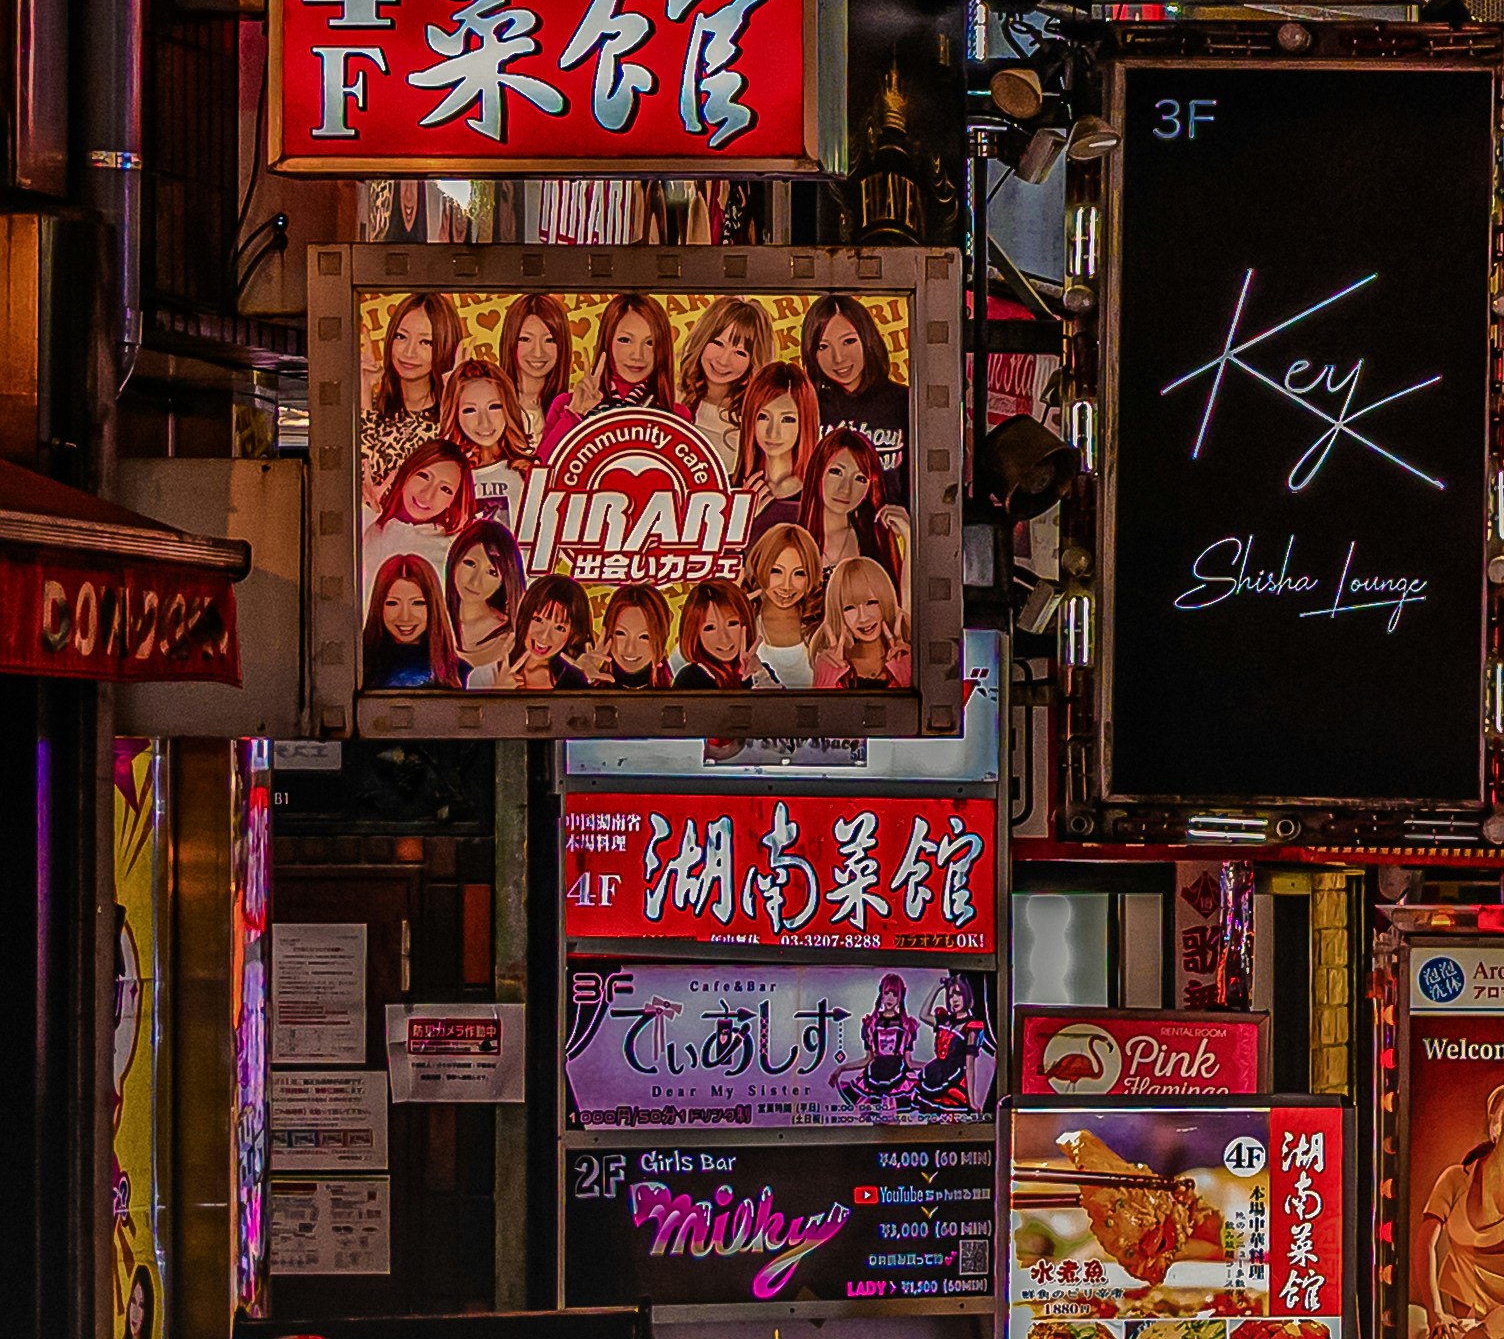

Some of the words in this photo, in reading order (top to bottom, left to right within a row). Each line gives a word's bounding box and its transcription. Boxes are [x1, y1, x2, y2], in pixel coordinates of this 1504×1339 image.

[1152, 98, 1218, 140] 3F
[1161, 267, 1445, 492] Key
[563, 432, 673, 488] community
[673, 440, 708, 485] cafe
[574, 552, 741, 583] 出会いカフェ
[1174, 534, 1320, 610] Shisha
[1299, 541, 1427, 634] Lounge
[643, 801, 984, 935] 湖南菜館
[566, 871, 622, 907] 4F
[780, 933, 881, 949] 03-3207-8288
[572, 973, 634, 1004] 3F
[689, 980, 778, 994] Cafe&Bar
[1125, 1035, 1220, 1079] Pink
[652, 1085, 697, 1099] Dear
[710, 1085, 735, 1100] My
[748, 1084, 812, 1099] Sister
[640, 1150, 694, 1174] Girls
[700, 1154, 737, 1172] Bar
[1225, 1143, 1265, 1169] 4F
[574, 1154, 627, 1199] 2F
[879, 1186, 924, 1204] YouTube
[1279, 1131, 1326, 1312] 湖南菜館
[1030, 1259, 1108, 1285] 水煮魚
[846, 1280, 888, 1298] LADY
